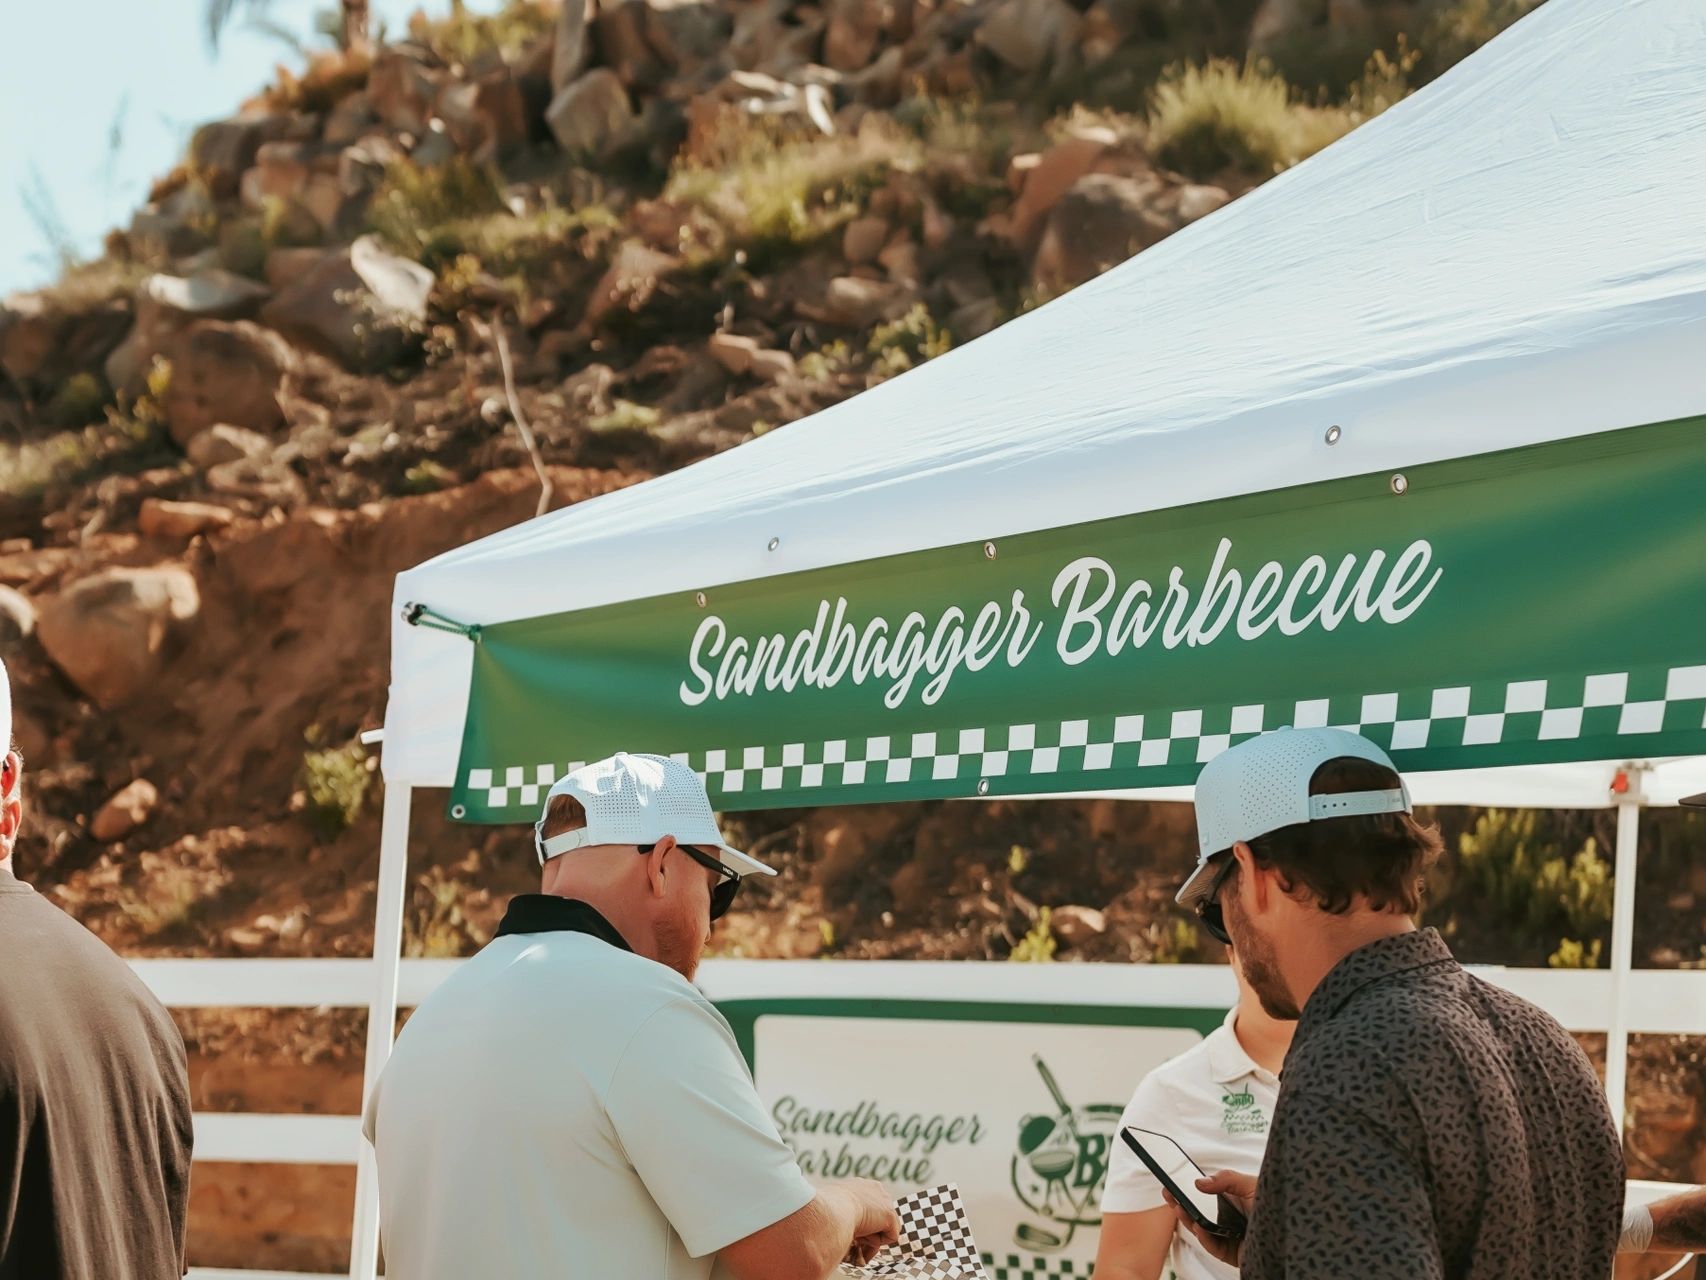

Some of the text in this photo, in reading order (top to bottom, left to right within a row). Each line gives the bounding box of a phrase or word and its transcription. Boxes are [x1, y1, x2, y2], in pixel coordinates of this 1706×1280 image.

[679, 537, 1443, 709] Sandbagger Barbecue
[772, 1095, 984, 1154] Sandbagger
[784, 1138, 934, 1184] arbecue
